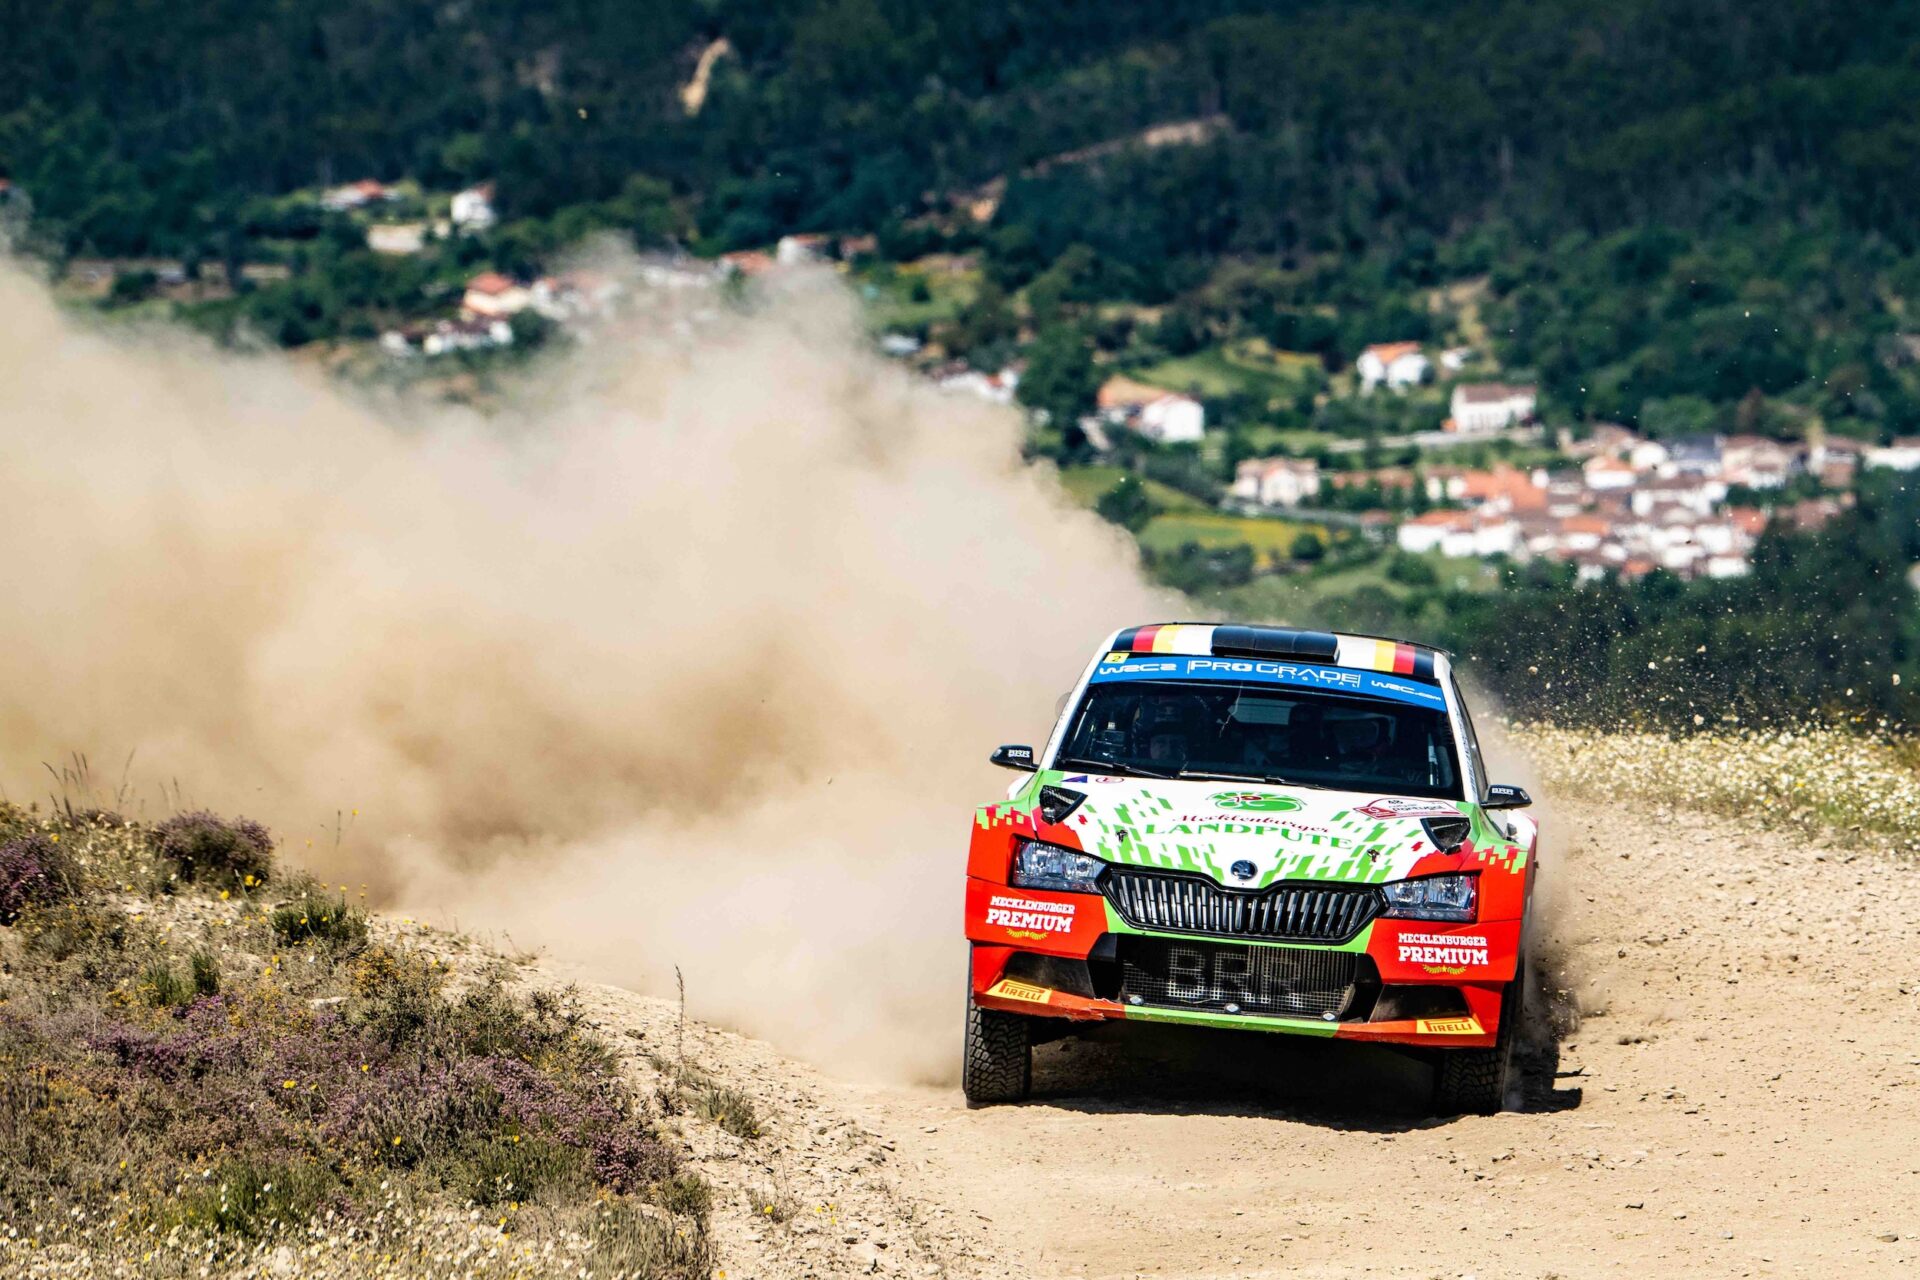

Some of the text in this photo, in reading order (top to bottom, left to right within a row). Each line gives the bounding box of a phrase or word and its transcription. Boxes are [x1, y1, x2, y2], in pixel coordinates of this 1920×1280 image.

[1100, 663, 1177, 675] WRC2
[1277, 673, 1356, 688] DIGITAL
[1172, 814, 1330, 833] Mecklenburger
[1145, 822, 1353, 850] LANDPUTE
[988, 895, 1076, 915] MECKLENBURGER
[985, 908, 1073, 933] PREMIUM
[1398, 932, 1488, 947] MECKLENBURGER
[1398, 945, 1489, 966] PREMIUM
[998, 980, 1046, 1002] PIRELLI
[1424, 1018, 1473, 1033] PIRELLI
